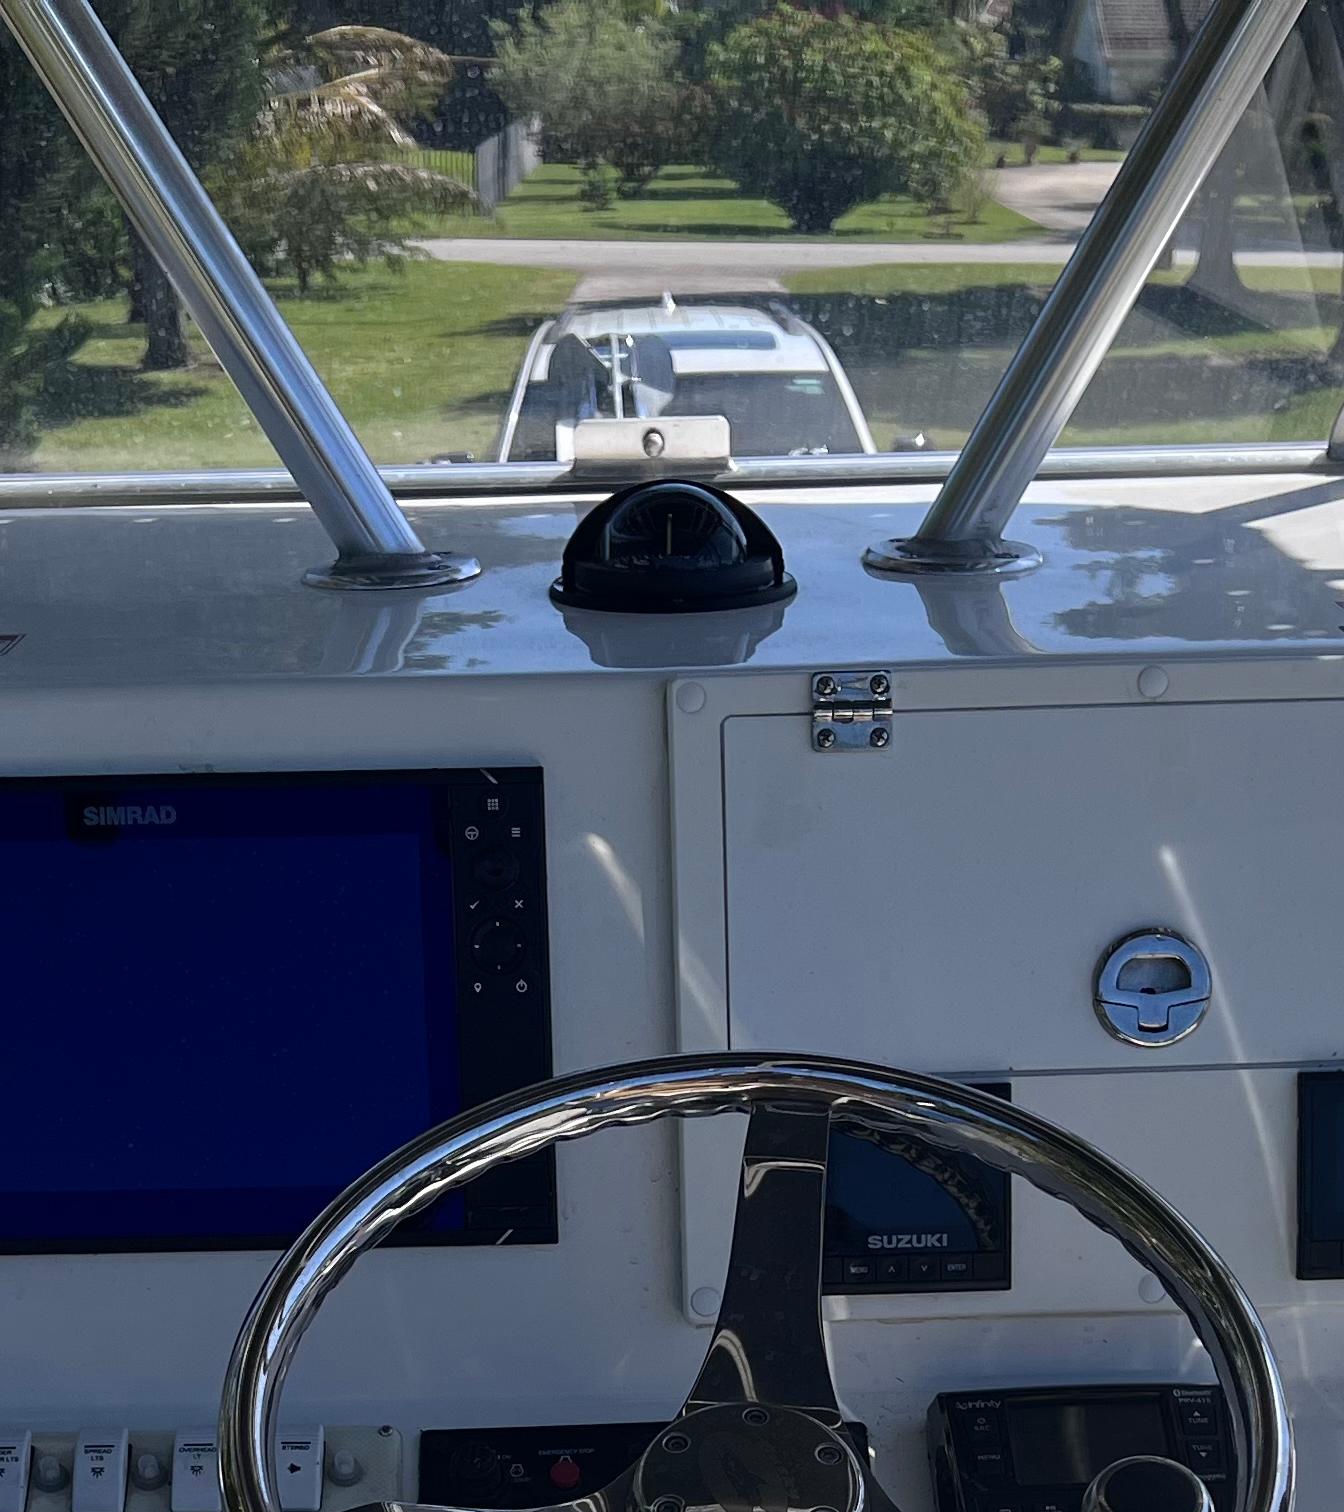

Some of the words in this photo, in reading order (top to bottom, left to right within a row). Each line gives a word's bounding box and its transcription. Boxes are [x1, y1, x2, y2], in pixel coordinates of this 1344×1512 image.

[82, 803, 177, 826] SIMRAD
[866, 1233, 948, 1249] SUZUKI
[946, 1263, 967, 1272] ENTER
[83, 1447, 113, 1455] SPREAD
